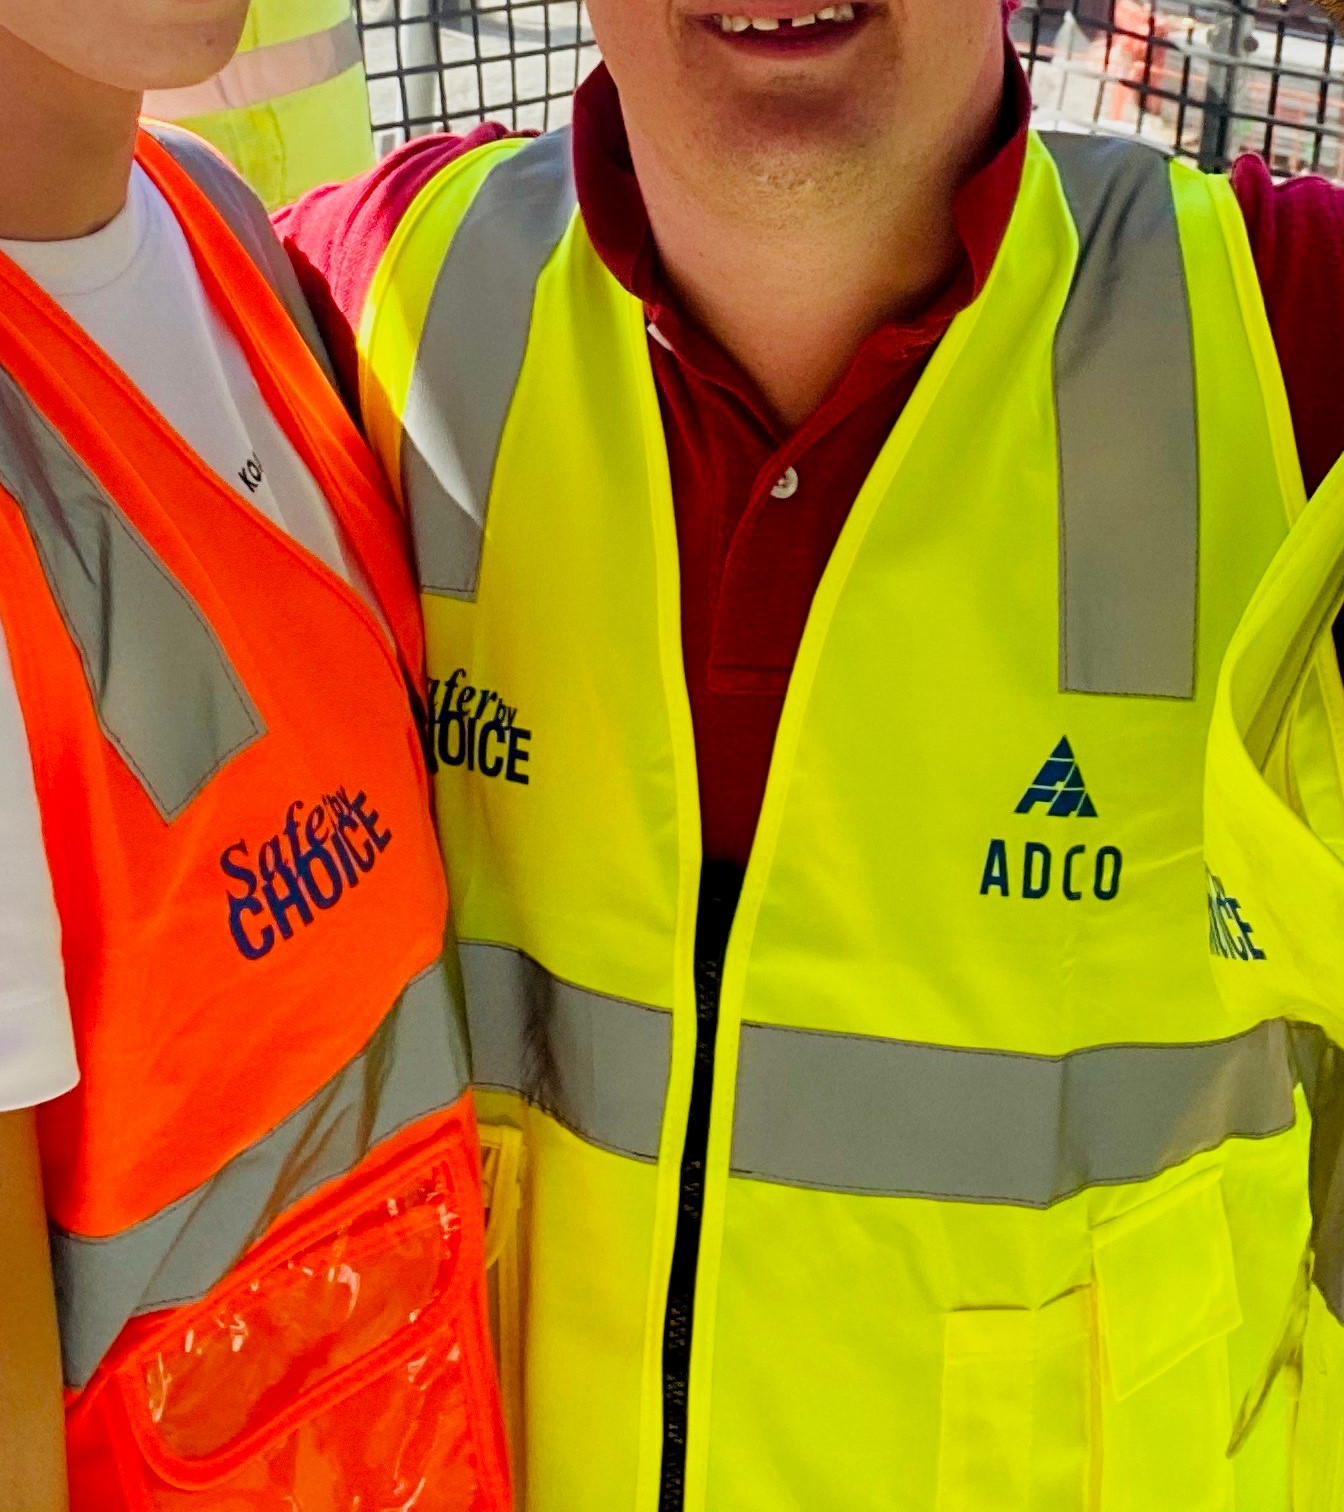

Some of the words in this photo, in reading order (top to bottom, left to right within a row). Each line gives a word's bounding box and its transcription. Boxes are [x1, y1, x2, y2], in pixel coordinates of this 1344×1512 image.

[237, 451, 264, 493] KO
[427, 716, 532, 786] OICE
[225, 789, 393, 961] CHOICE
[979, 837, 1123, 901] ADCO
